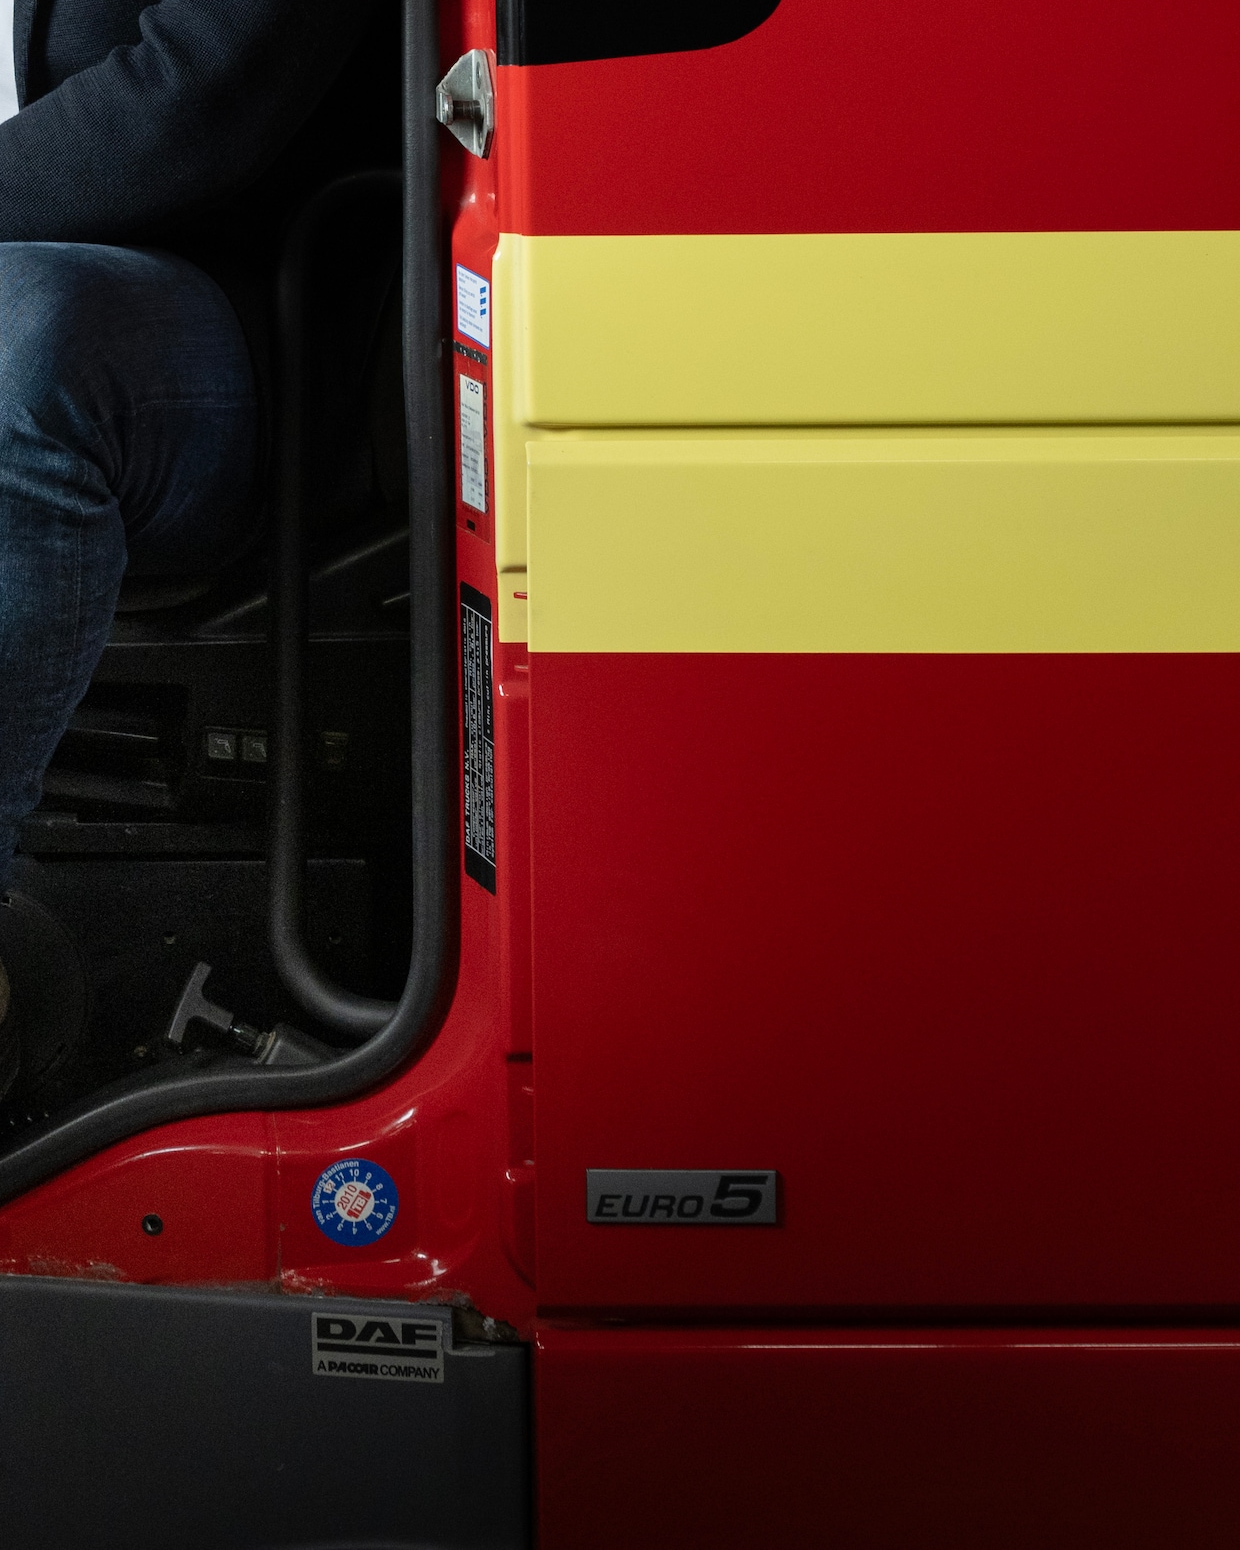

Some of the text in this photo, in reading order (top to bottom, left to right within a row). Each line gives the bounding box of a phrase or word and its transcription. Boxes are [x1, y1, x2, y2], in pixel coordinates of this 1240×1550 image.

[465, 379, 479, 394] VDO
[334, 1172, 345, 1181] 11
[349, 1169, 360, 1177] 10
[365, 1172, 372, 1180] 9
[312, 1160, 360, 1225] van Tilburg-Bastianen
[337, 1184, 358, 1211] 2010
[594, 1175, 769, 1219] EURO 5
[325, 1212, 334, 1220] 2
[376, 1212, 384, 1220] 6
[336, 1223, 344, 1231] 3
[352, 1227, 358, 1235] 4
[365, 1223, 373, 1231] 5
[316, 1317, 438, 1346] DAF
[317, 1359, 327, 1372] A
[379, 1364, 440, 1380] COMPANY
